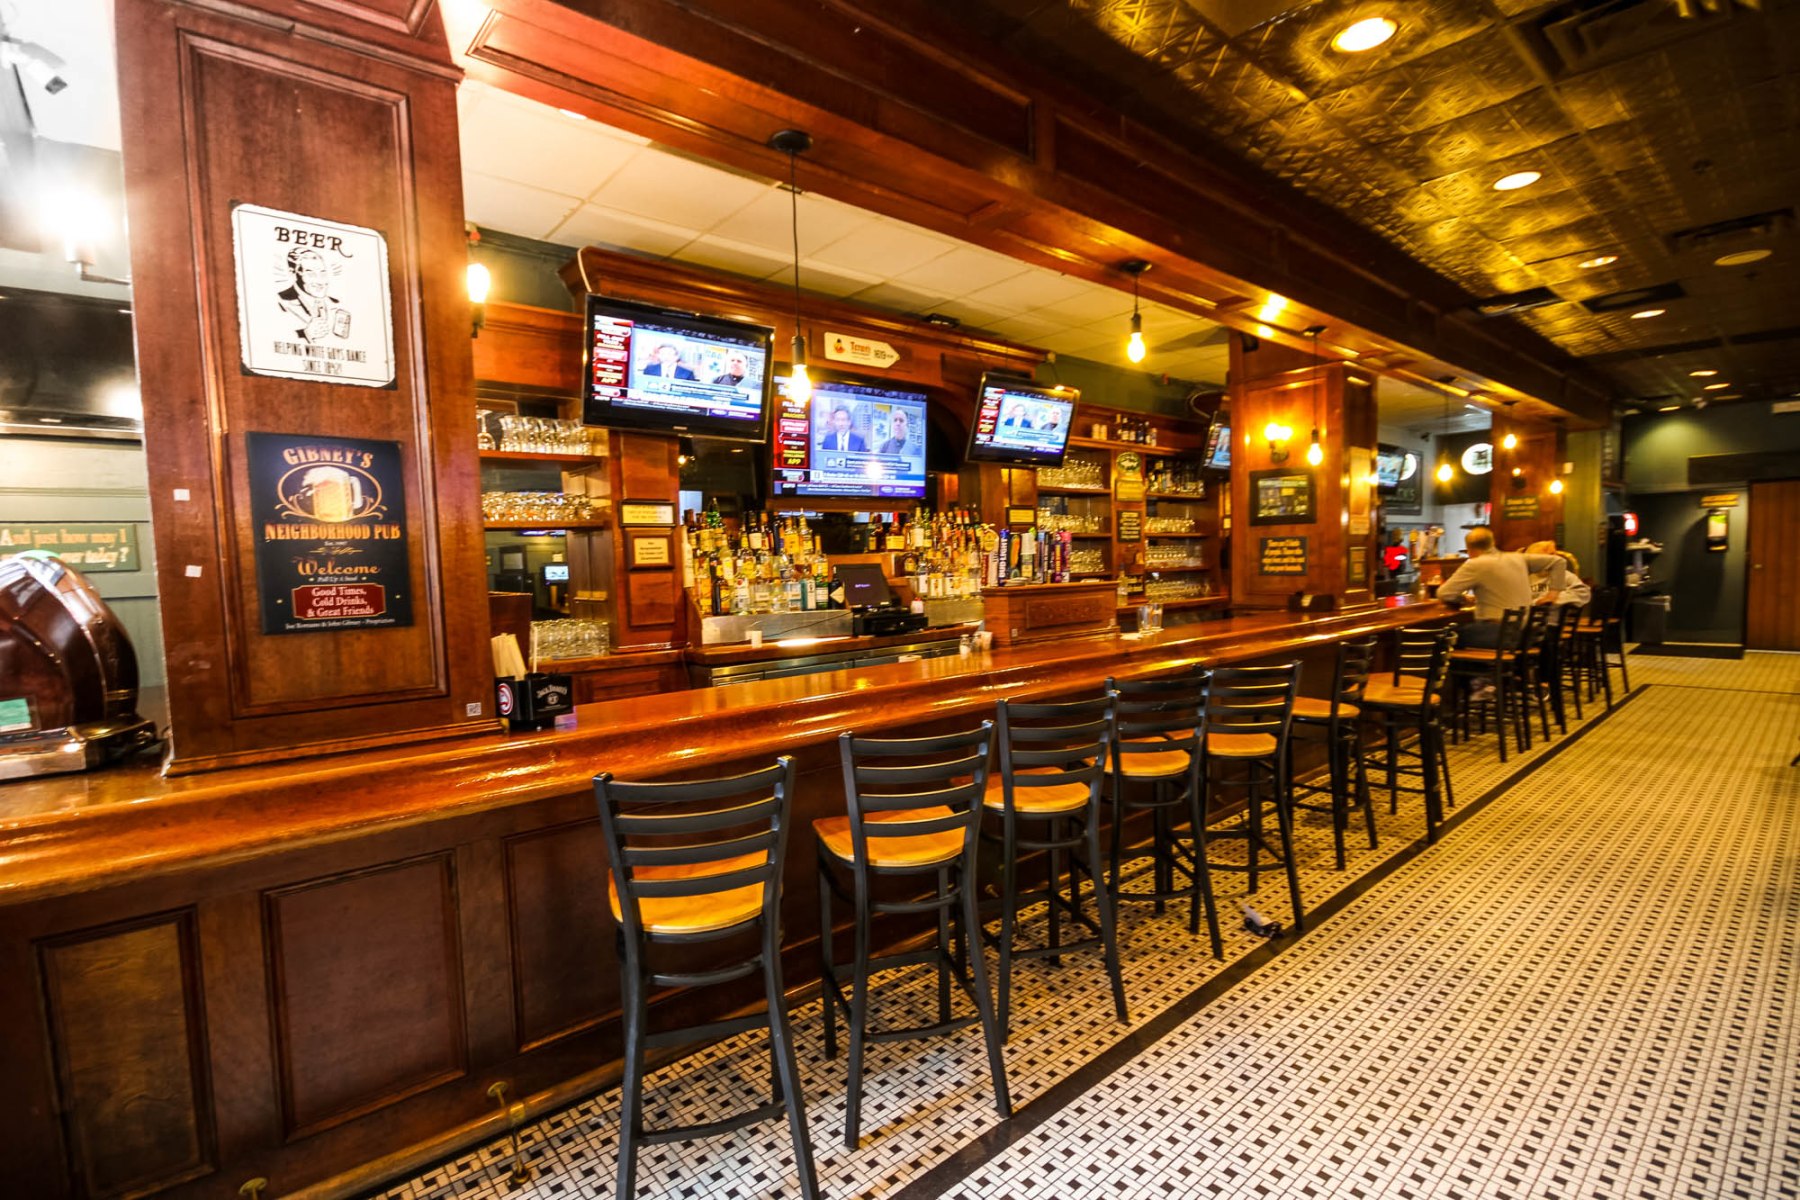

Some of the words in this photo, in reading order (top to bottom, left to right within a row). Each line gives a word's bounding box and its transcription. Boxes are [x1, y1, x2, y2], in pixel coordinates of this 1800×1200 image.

[274, 227, 353, 258] BEER
[274, 341, 302, 356] HELPING
[304, 345, 325, 359] WHITE
[327, 346, 345, 360] GUYS
[346, 349, 367, 363] DANCE
[302, 360, 321, 373] SINCE
[282, 446, 374, 468] GIBNEY'S
[0, 528, 32, 546] And
[264, 522, 371, 541] NEIGHBORHOOD
[373, 523, 401, 540] PUB
[999, 538, 1008, 561] LIGHT
[293, 557, 381, 576] Welcome
[998, 560, 1007, 578] BUD
[311, 587, 337, 597] Good
[312, 597, 334, 607] Cold
[306, 609, 316, 618] &
[316, 607, 341, 618] Great
[342, 605, 375, 617] Friends
